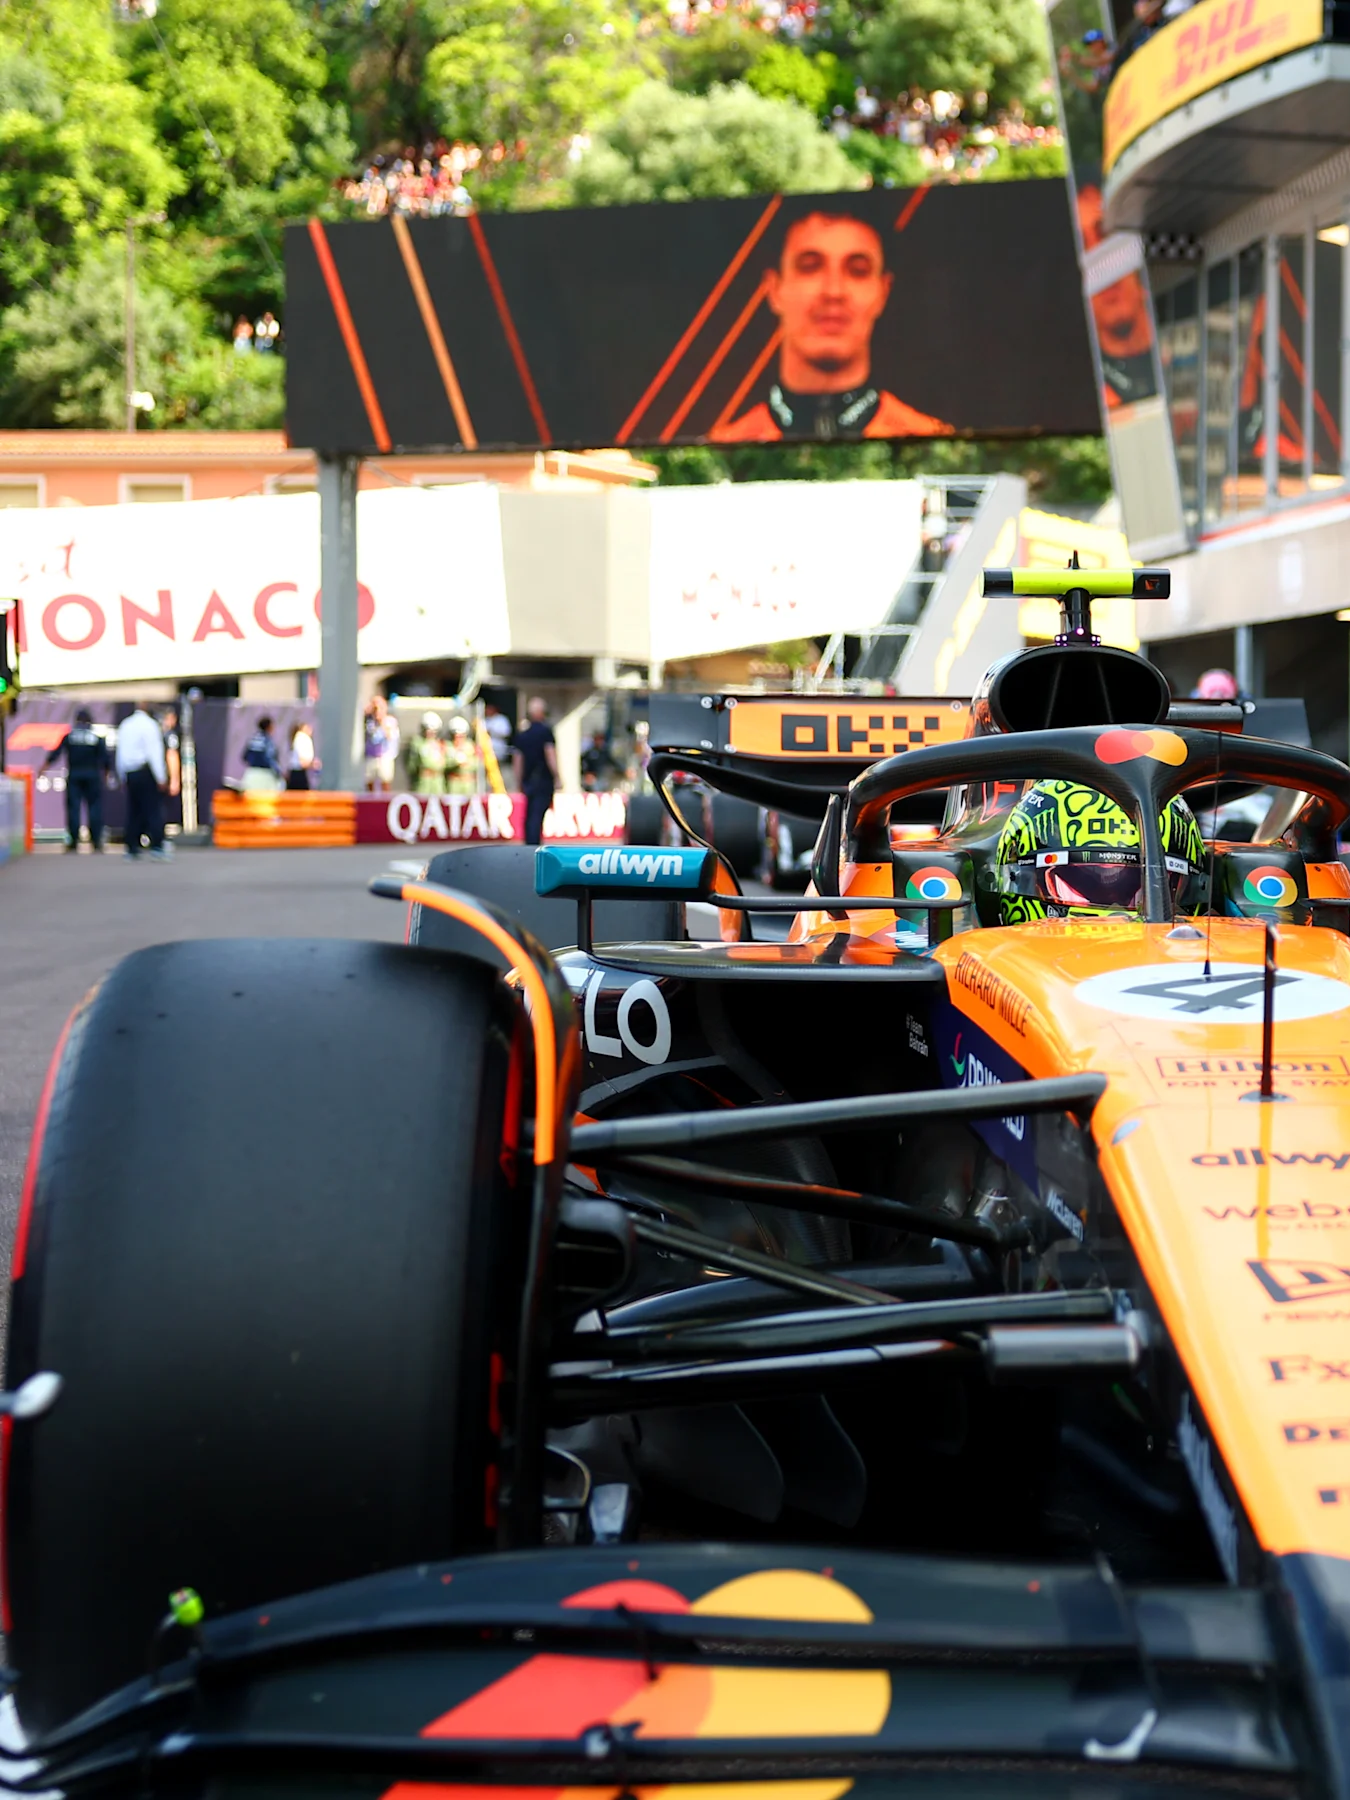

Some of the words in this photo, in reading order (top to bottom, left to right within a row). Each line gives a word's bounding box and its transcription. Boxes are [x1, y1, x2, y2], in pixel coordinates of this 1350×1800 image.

[18, 581, 375, 654] ONAC
[387, 793, 514, 843] QATAR
[578, 849, 683, 882] allwyn
[1099, 851, 1137, 861] MONSTER
[562, 967, 671, 1064] LO
[954, 951, 999, 1010] RICHARD
[998, 982, 1033, 1037] MILLE
[1119, 971, 1304, 1014] 4
[1175, 1060, 1333, 1073] Hilton
